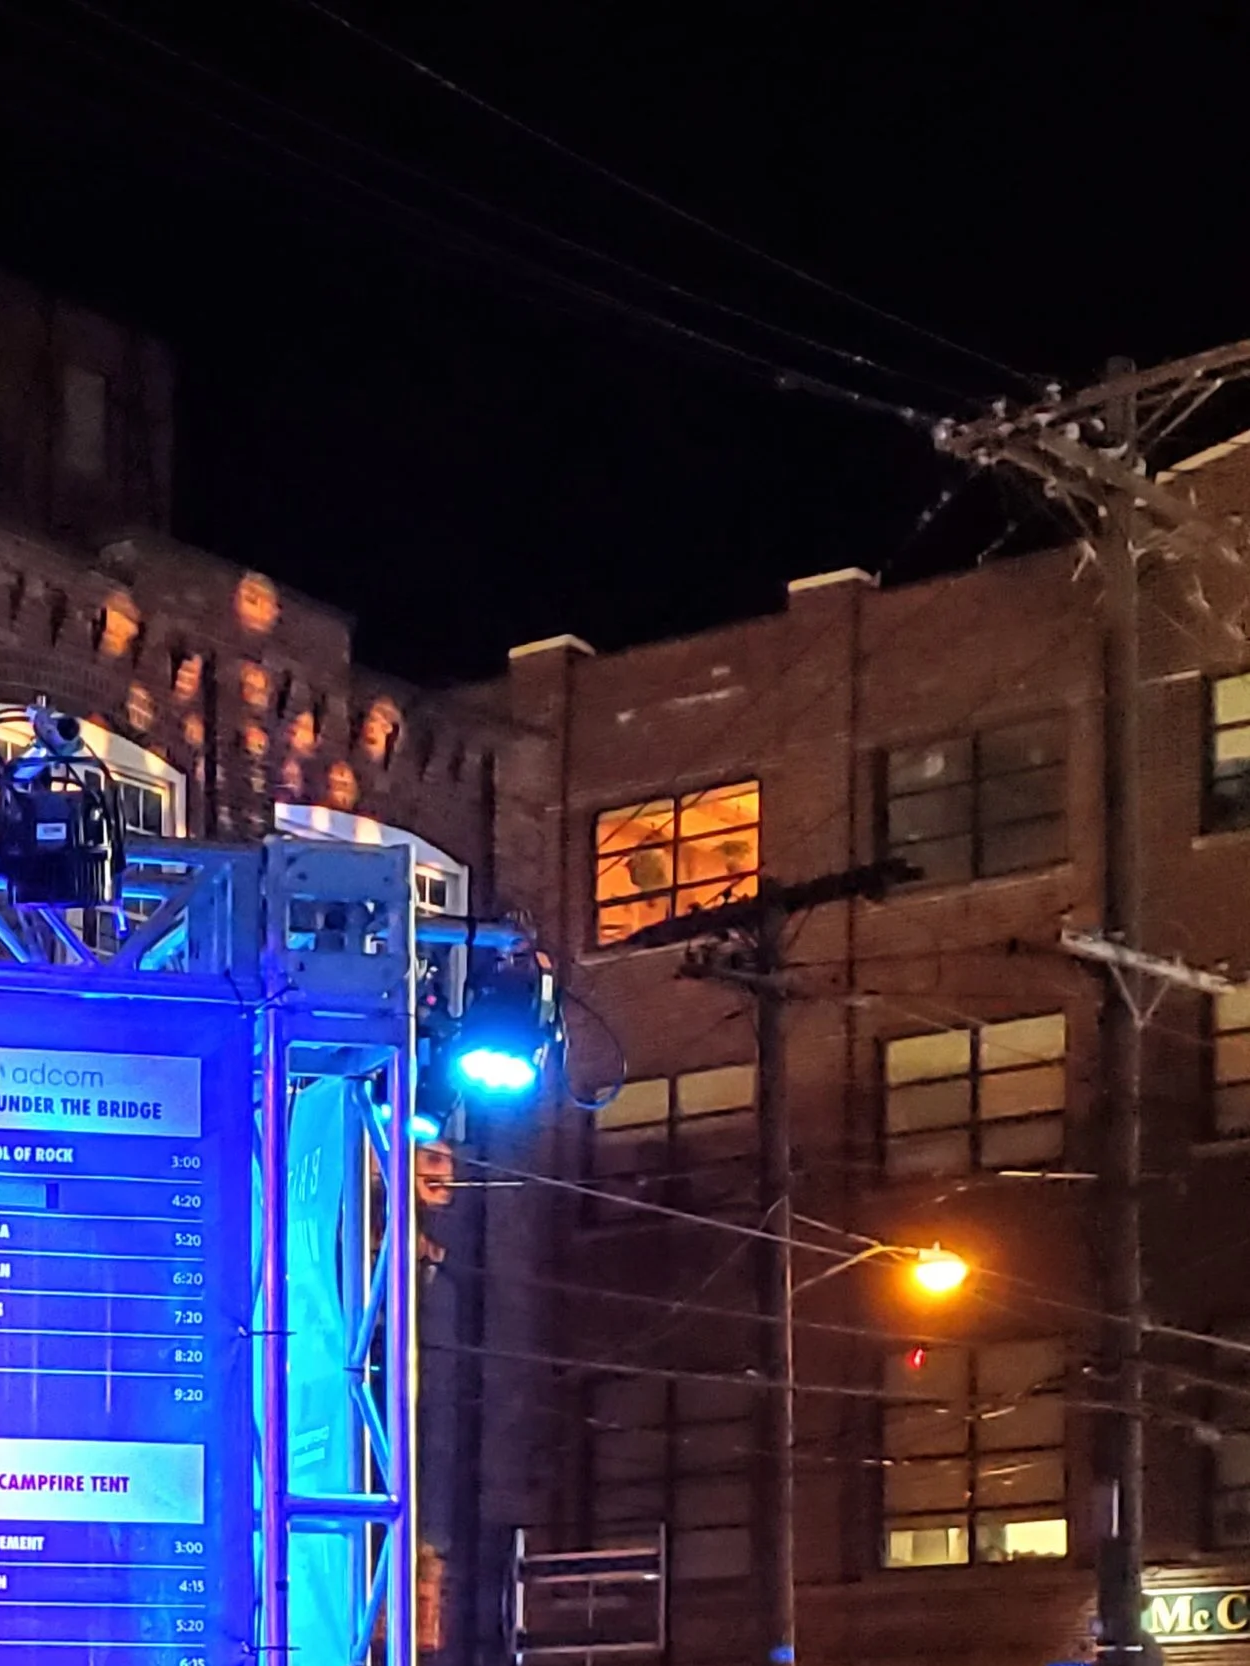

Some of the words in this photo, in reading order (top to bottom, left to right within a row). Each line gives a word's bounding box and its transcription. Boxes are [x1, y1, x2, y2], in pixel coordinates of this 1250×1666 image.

[12, 1063, 104, 1088] adcom
[60, 1098, 91, 1116] THE
[98, 1100, 162, 1120] BRIDGE
[14, 1146, 32, 1162] OF
[35, 1146, 73, 1163] ROCK
[171, 1155, 201, 1168] 3:00
[172, 1195, 201, 1208] 4:20
[175, 1234, 201, 1247] 5:20
[173, 1272, 203, 1285] 6:20
[175, 1311, 203, 1325] 7:20
[175, 1350, 203, 1363] 8:20
[175, 1388, 203, 1402] 9:20
[90, 1476, 130, 1493] TENT
[174, 1542, 203, 1555] 3:00
[179, 1580, 204, 1593] 4:15
[176, 1619, 204, 1633] 5:20
